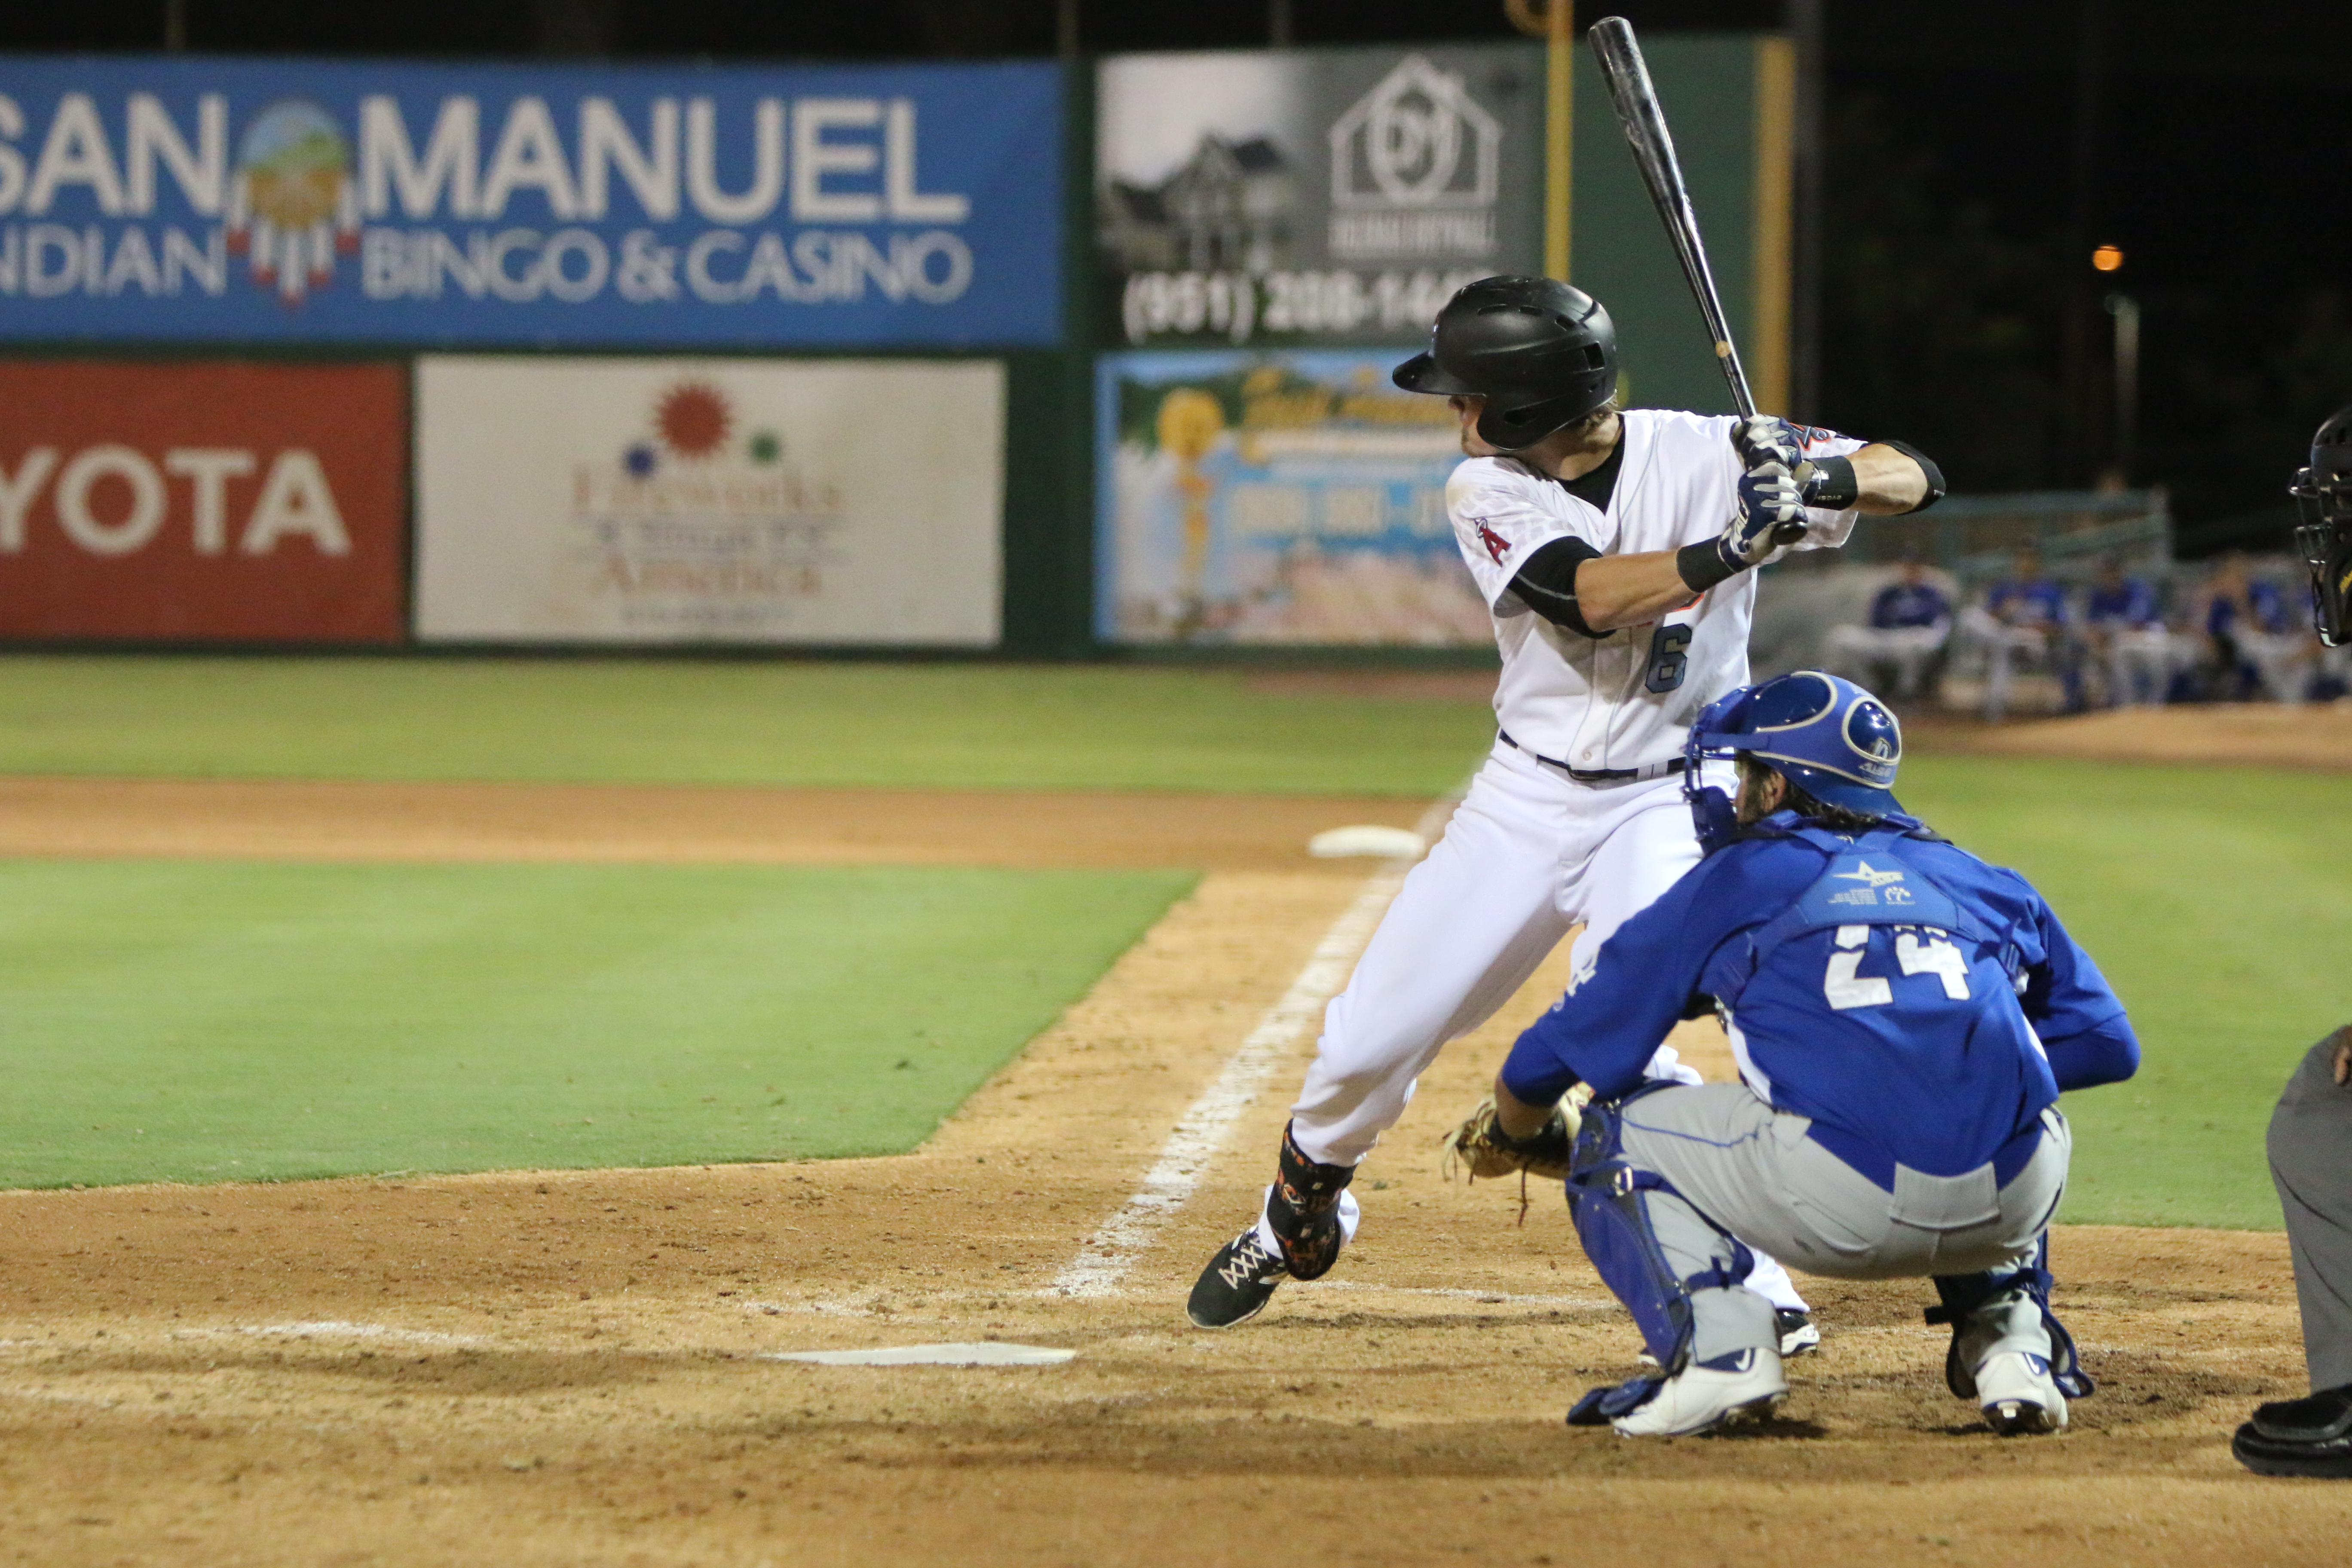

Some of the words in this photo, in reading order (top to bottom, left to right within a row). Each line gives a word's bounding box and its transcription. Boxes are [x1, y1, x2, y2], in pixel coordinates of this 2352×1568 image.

[358, 95, 972, 224] MANUEL
[362, 226, 610, 304] BINGO
[617, 228, 681, 305] &
[686, 228, 973, 306] CASINO
[1123, 272, 1254, 344] (951)
[0, 444, 352, 558] YOTA
[1645, 623, 1693, 694] 6
[1824, 925, 1970, 1011] 24
